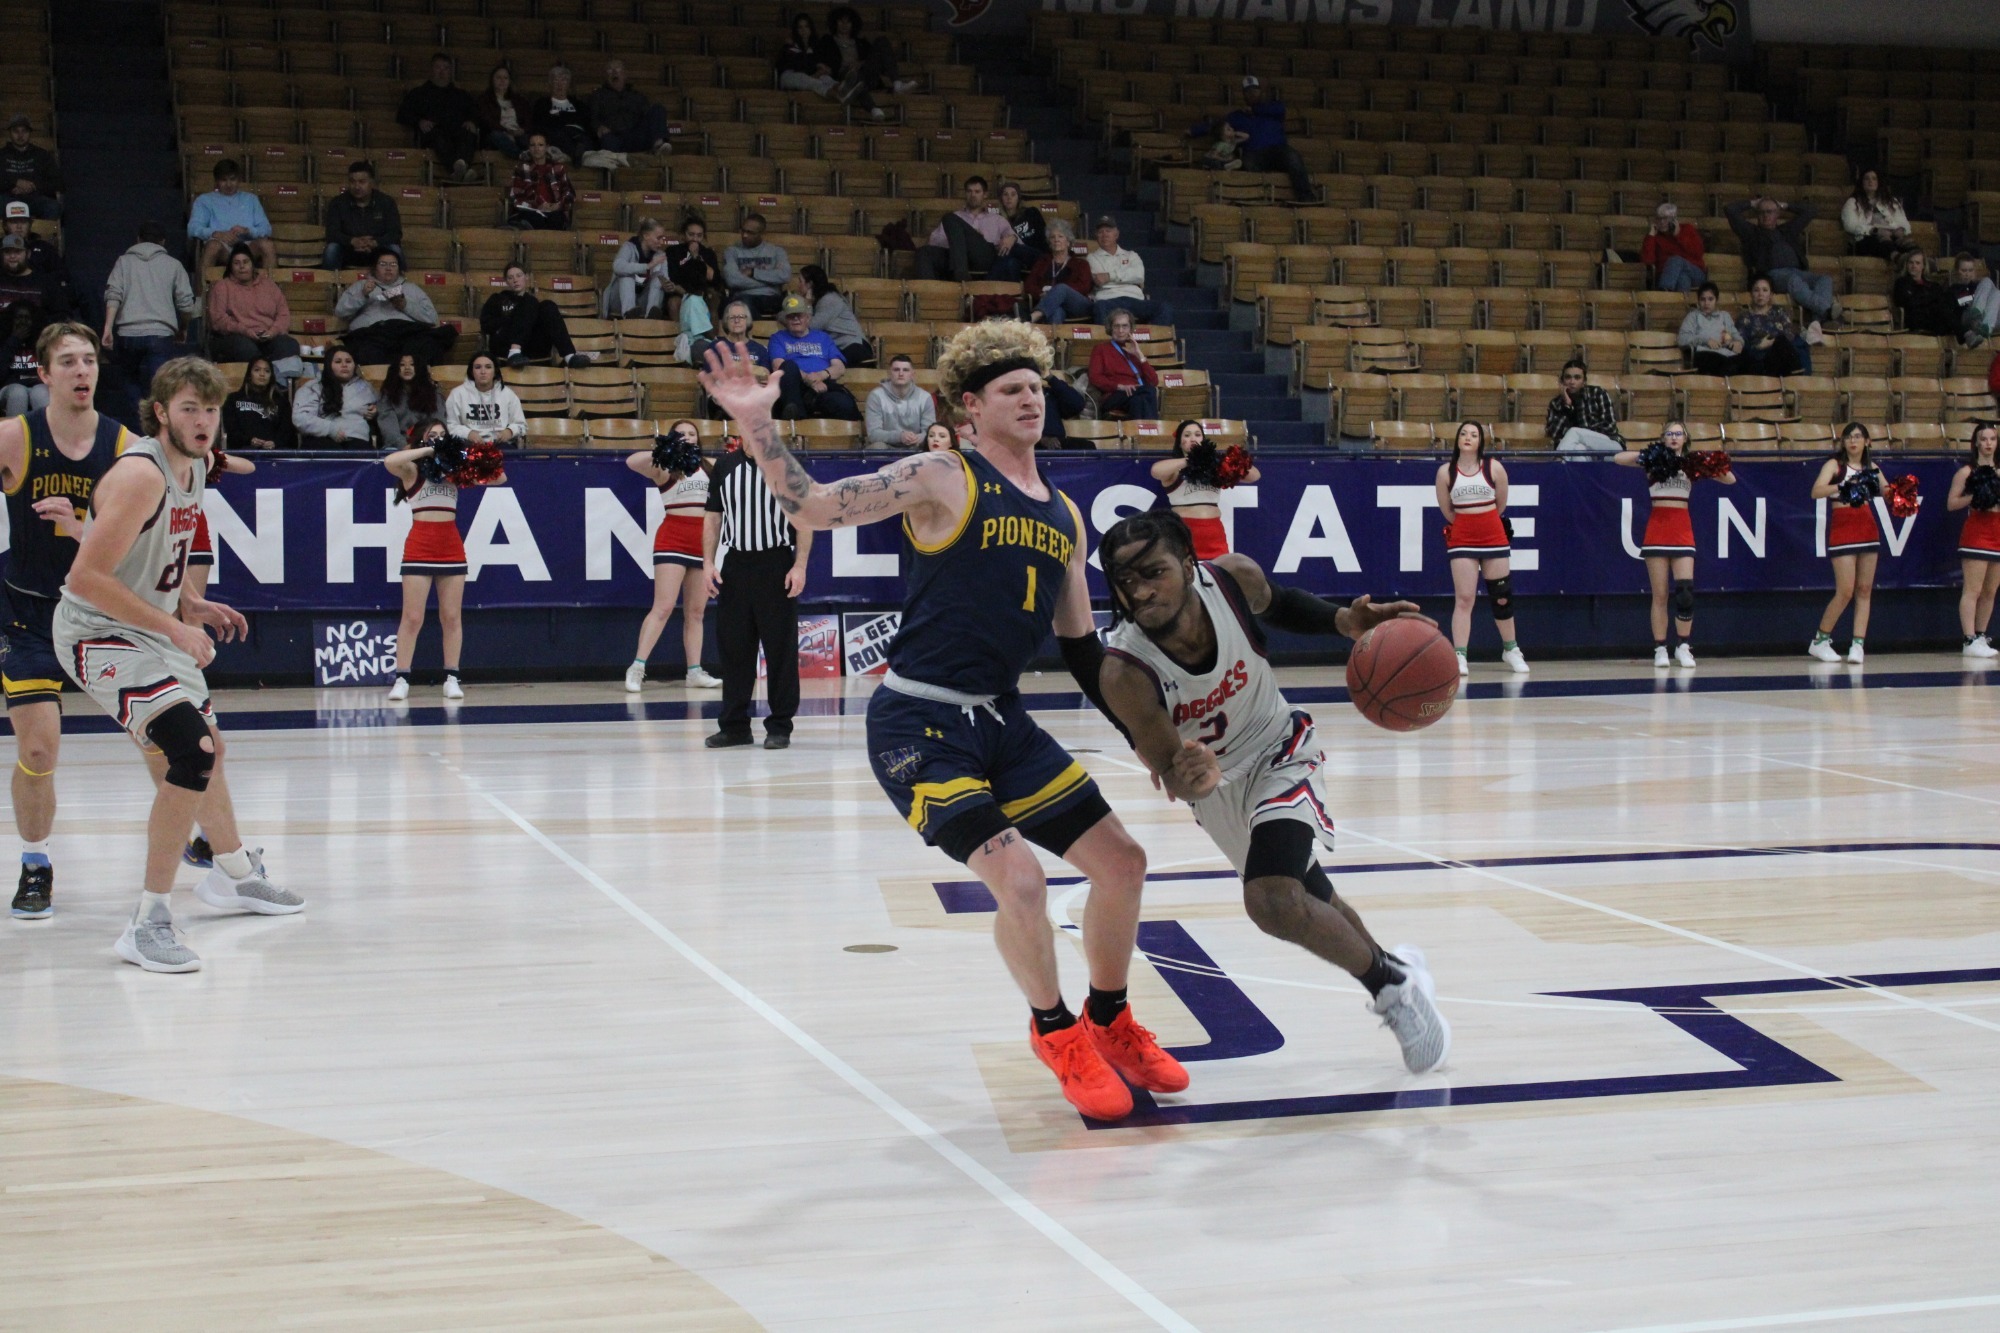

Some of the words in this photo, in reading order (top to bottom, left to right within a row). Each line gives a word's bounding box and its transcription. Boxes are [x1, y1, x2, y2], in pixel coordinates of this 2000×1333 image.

[1022, 565, 1037, 613] 1
[326, 620, 368, 643] NO
[864, 614, 899, 641] GET
[315, 634, 397, 668] MAN'S
[321, 655, 397, 685] LAND
[1172, 660, 1248, 727] AGGIES
[1197, 711, 1228, 756] 2
